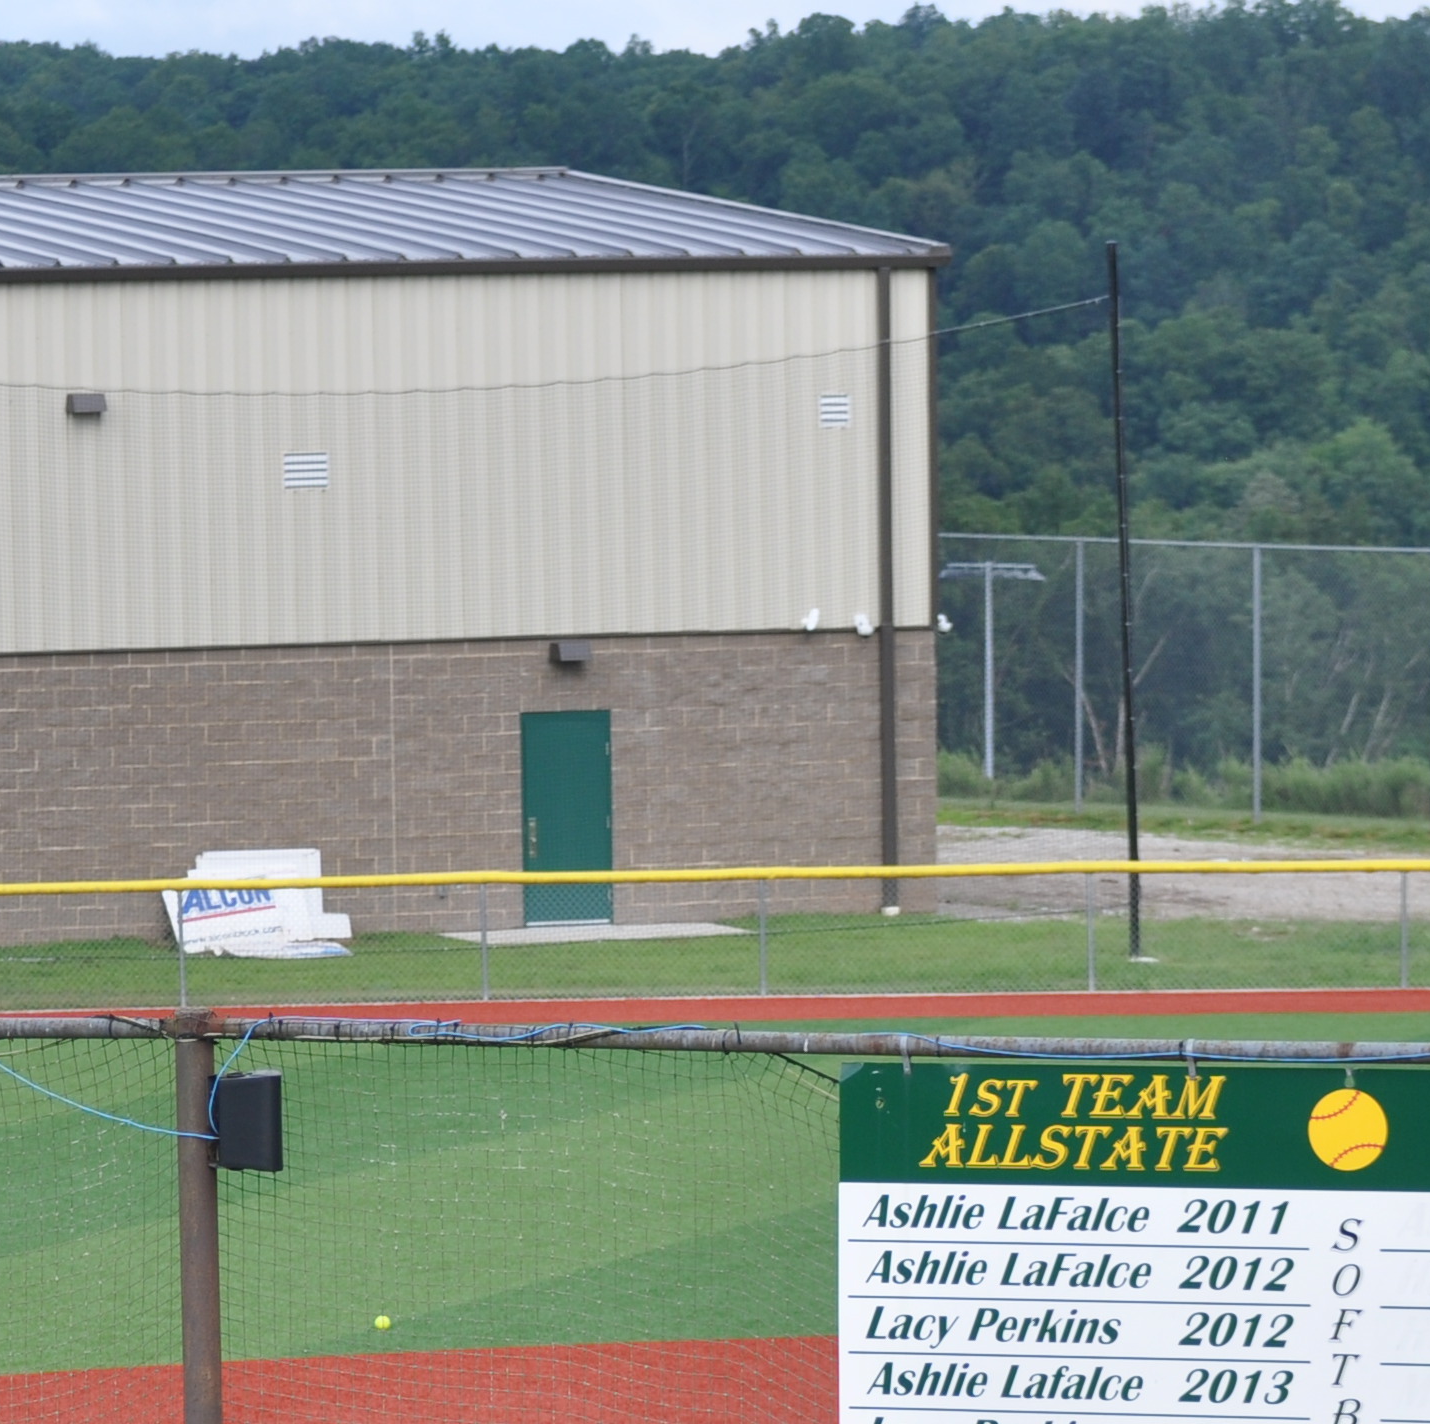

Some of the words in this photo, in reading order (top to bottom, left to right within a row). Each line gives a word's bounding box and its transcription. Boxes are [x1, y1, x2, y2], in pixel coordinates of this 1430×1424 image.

[944, 1072, 1038, 1118] 1ST
[1060, 1073, 1226, 1120] TEAM
[919, 1123, 1228, 1171] ALLSTATE
[862, 1194, 985, 1229] Ashlie
[997, 1196, 1150, 1232] LaFalce
[1176, 1199, 1289, 1235] 2011
[866, 1250, 987, 1285] Ashlie
[1000, 1252, 1152, 1288] LaFalce
[1178, 1255, 1294, 1291] 2012
[865, 1305, 959, 1348] Lacy
[968, 1307, 1121, 1345] Perkins
[1178, 1312, 1294, 1348] 2012
[866, 1362, 988, 1396] Ashlie
[1000, 1365, 1144, 1401] Lafalce
[1178, 1368, 1294, 1404] 2013
